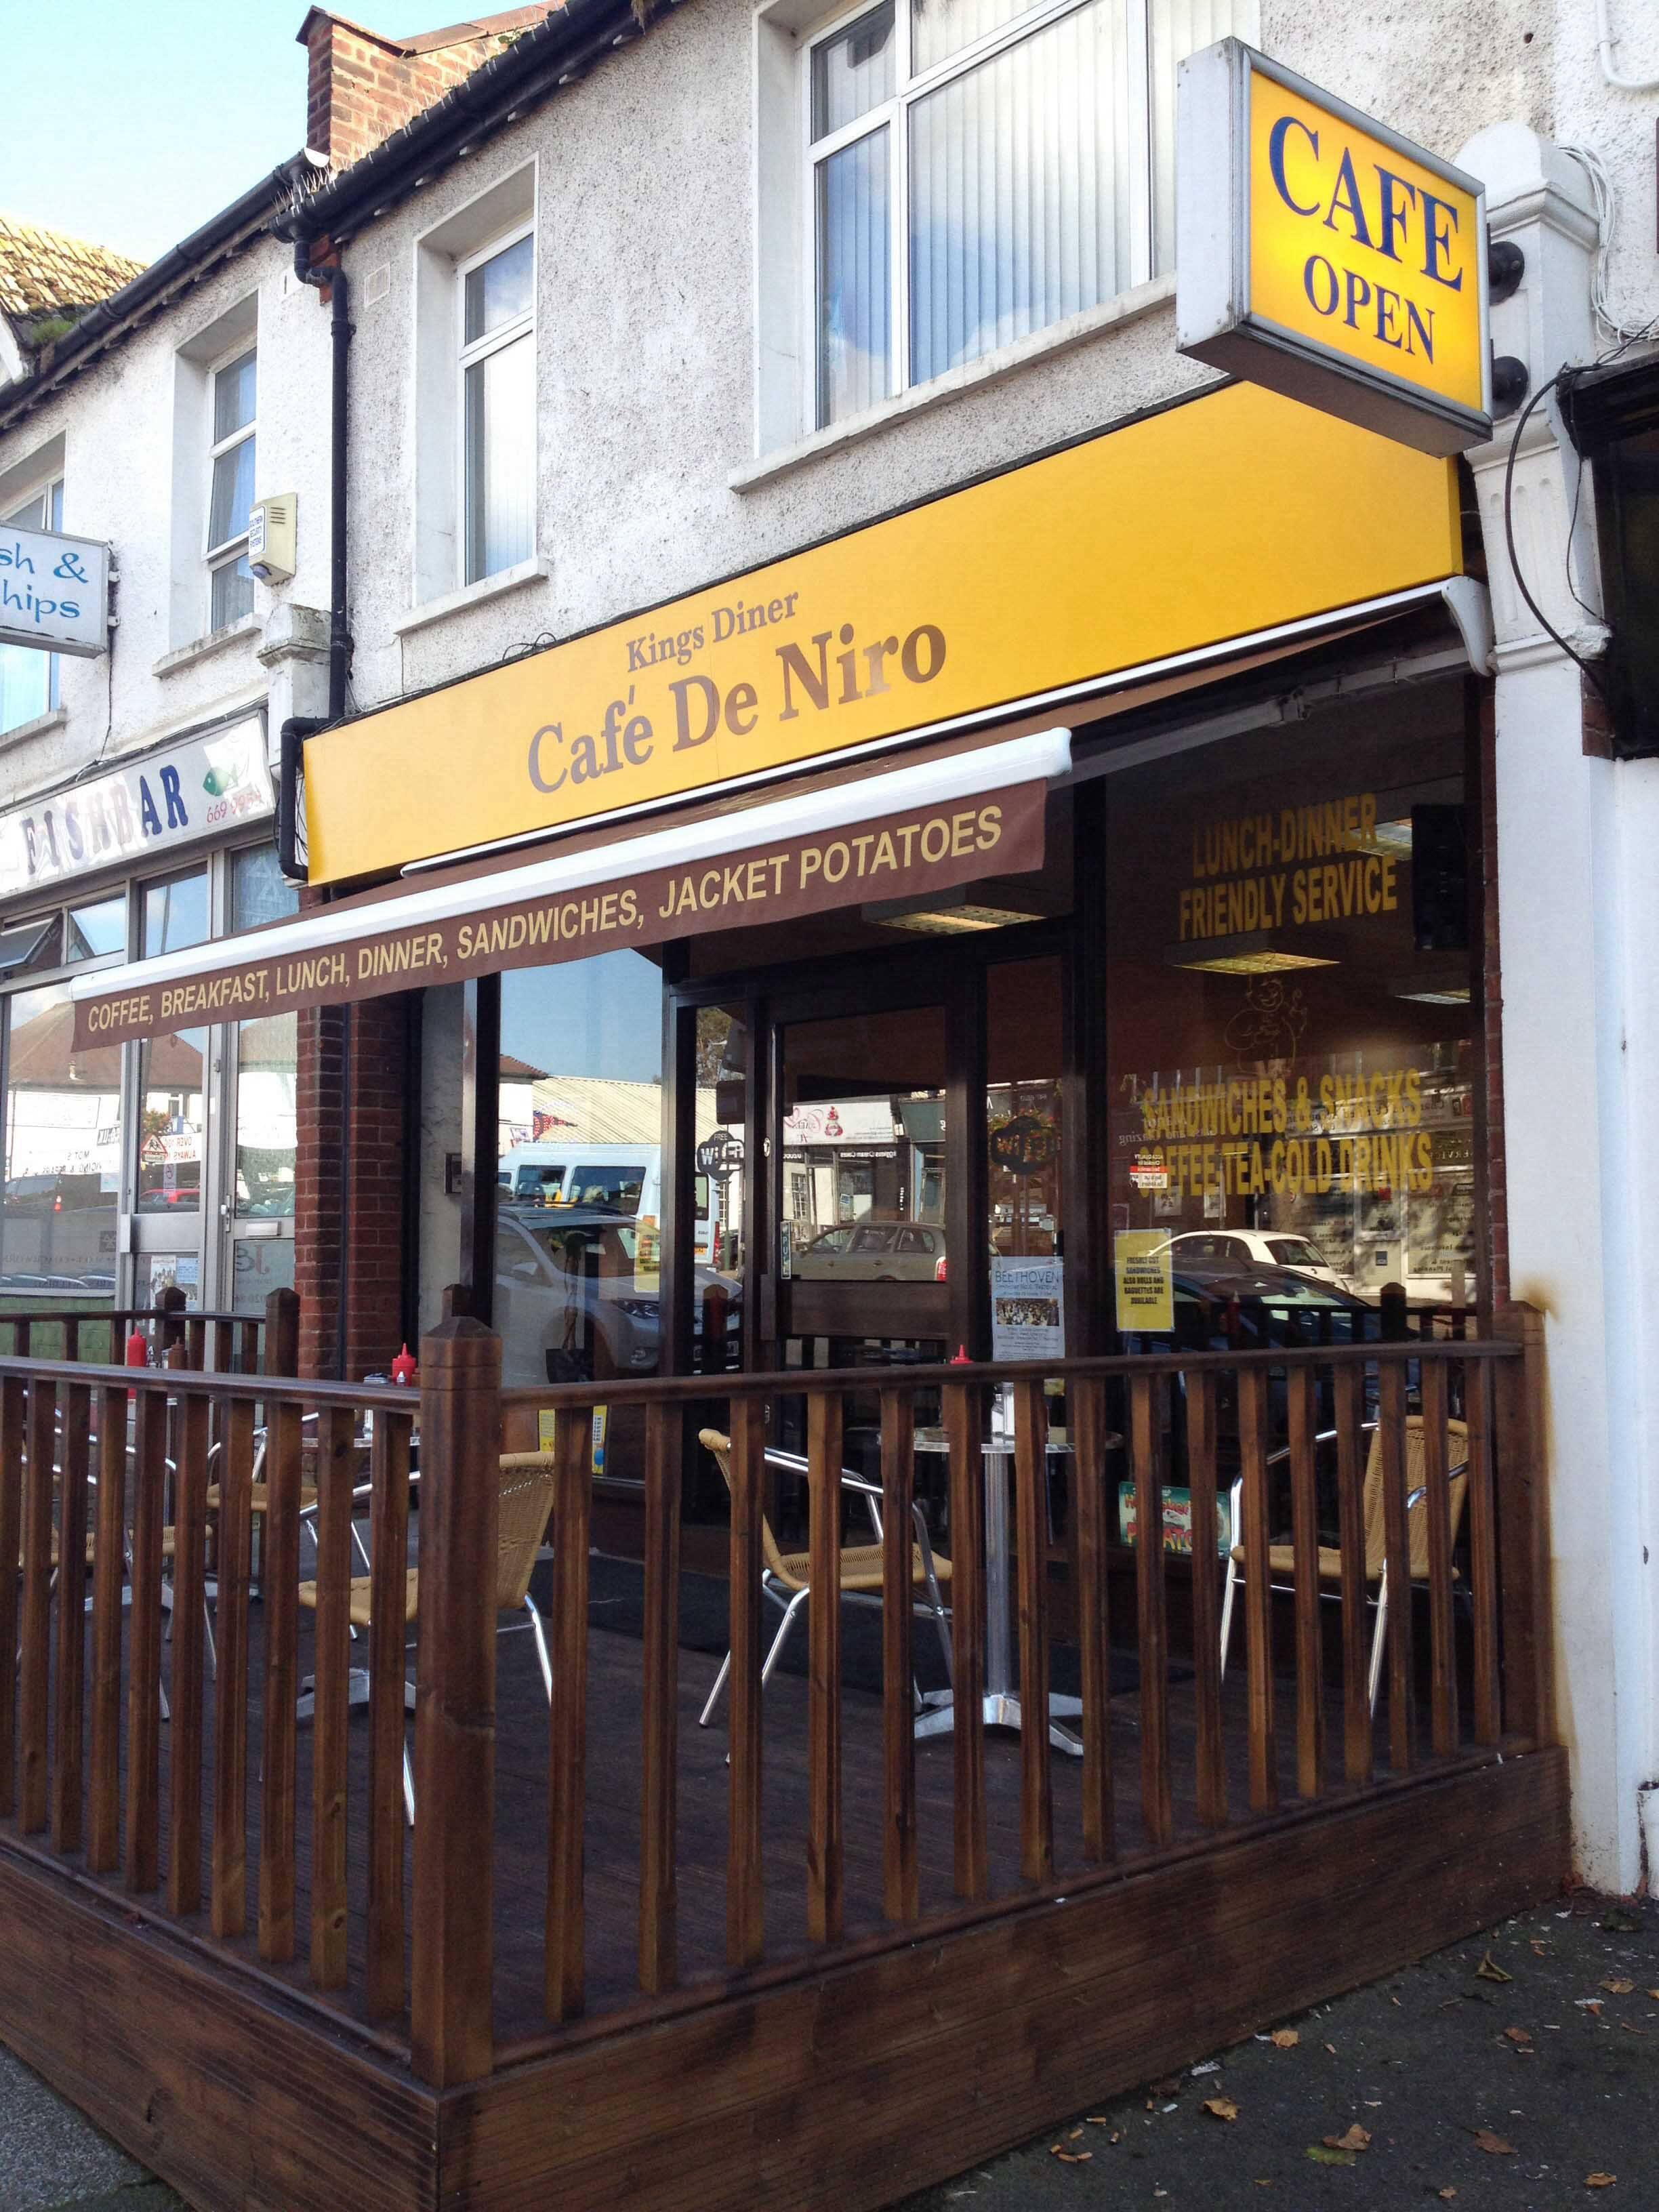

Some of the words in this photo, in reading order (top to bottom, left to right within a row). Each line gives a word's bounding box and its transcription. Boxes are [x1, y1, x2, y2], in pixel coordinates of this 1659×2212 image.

[1269, 116, 1462, 292] CAFE
[1304, 255, 1435, 365] OPEN
[54, 552, 89, 584] &
[626, 625, 703, 673] Kings
[712, 592, 798, 643] Diner
[528, 684, 653, 794] Café
[668, 674, 758, 752] De
[775, 623, 947, 722] Niro
[207, 801, 228, 823] 669
[1193, 792, 1377, 879] LUNCH-DINNER
[88, 994, 154, 1032] COFFEE,
[161, 969, 269, 1018] BREAKFAST,
[276, 953, 350, 996] LUNCH,
[359, 933, 448, 980] DINNER,
[457, 889, 644, 954] SANDWICHES,
[658, 853, 790, 919] JACKET
[800, 805, 1003, 890] POTATOES
[1179, 874, 1286, 942] FRIENDLY
[1292, 856, 1398, 926] SERVICE
[1143, 1078, 1286, 1139] SANDWICHES
[1296, 1076, 1311, 1130] &
[1320, 1068, 1421, 1130] SNACKS
[1338, 1132, 1434, 1193] DRINKS
[995, 1271, 1059, 1284] BEETHOVEN
